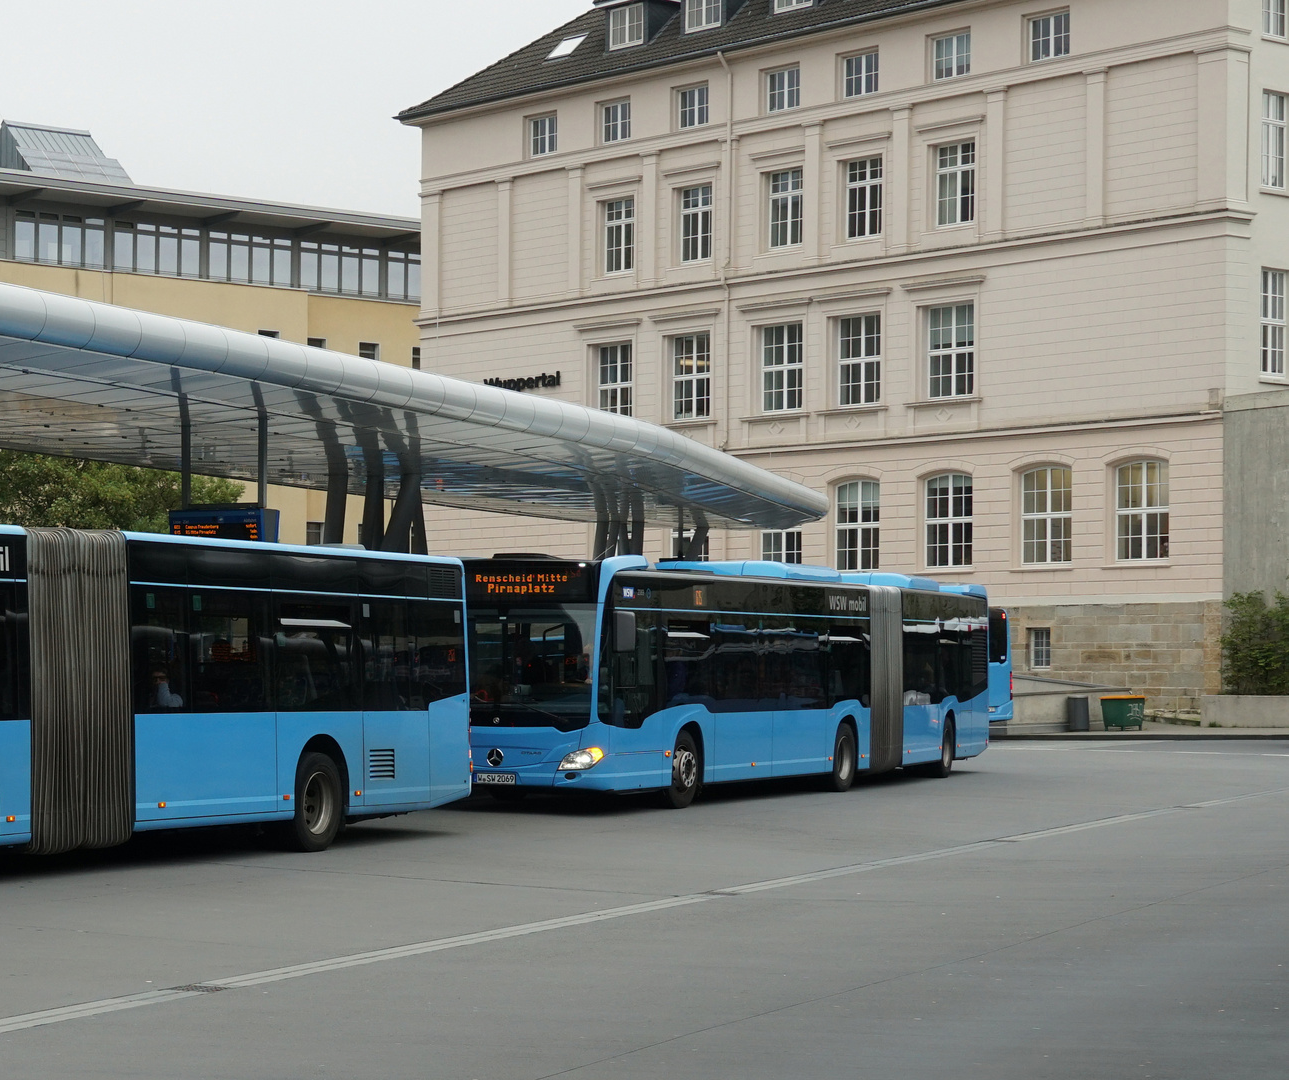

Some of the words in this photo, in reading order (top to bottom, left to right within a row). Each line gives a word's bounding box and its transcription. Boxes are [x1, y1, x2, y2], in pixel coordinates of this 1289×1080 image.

[537, 573, 568, 582] Mitte
[487, 583, 554, 594] Pirnaplatz
[829, 596, 847, 610] WSW
[849, 596, 866, 611] mobil
[487, 774, 496, 782] SW
[497, 774, 515, 783] 2069
